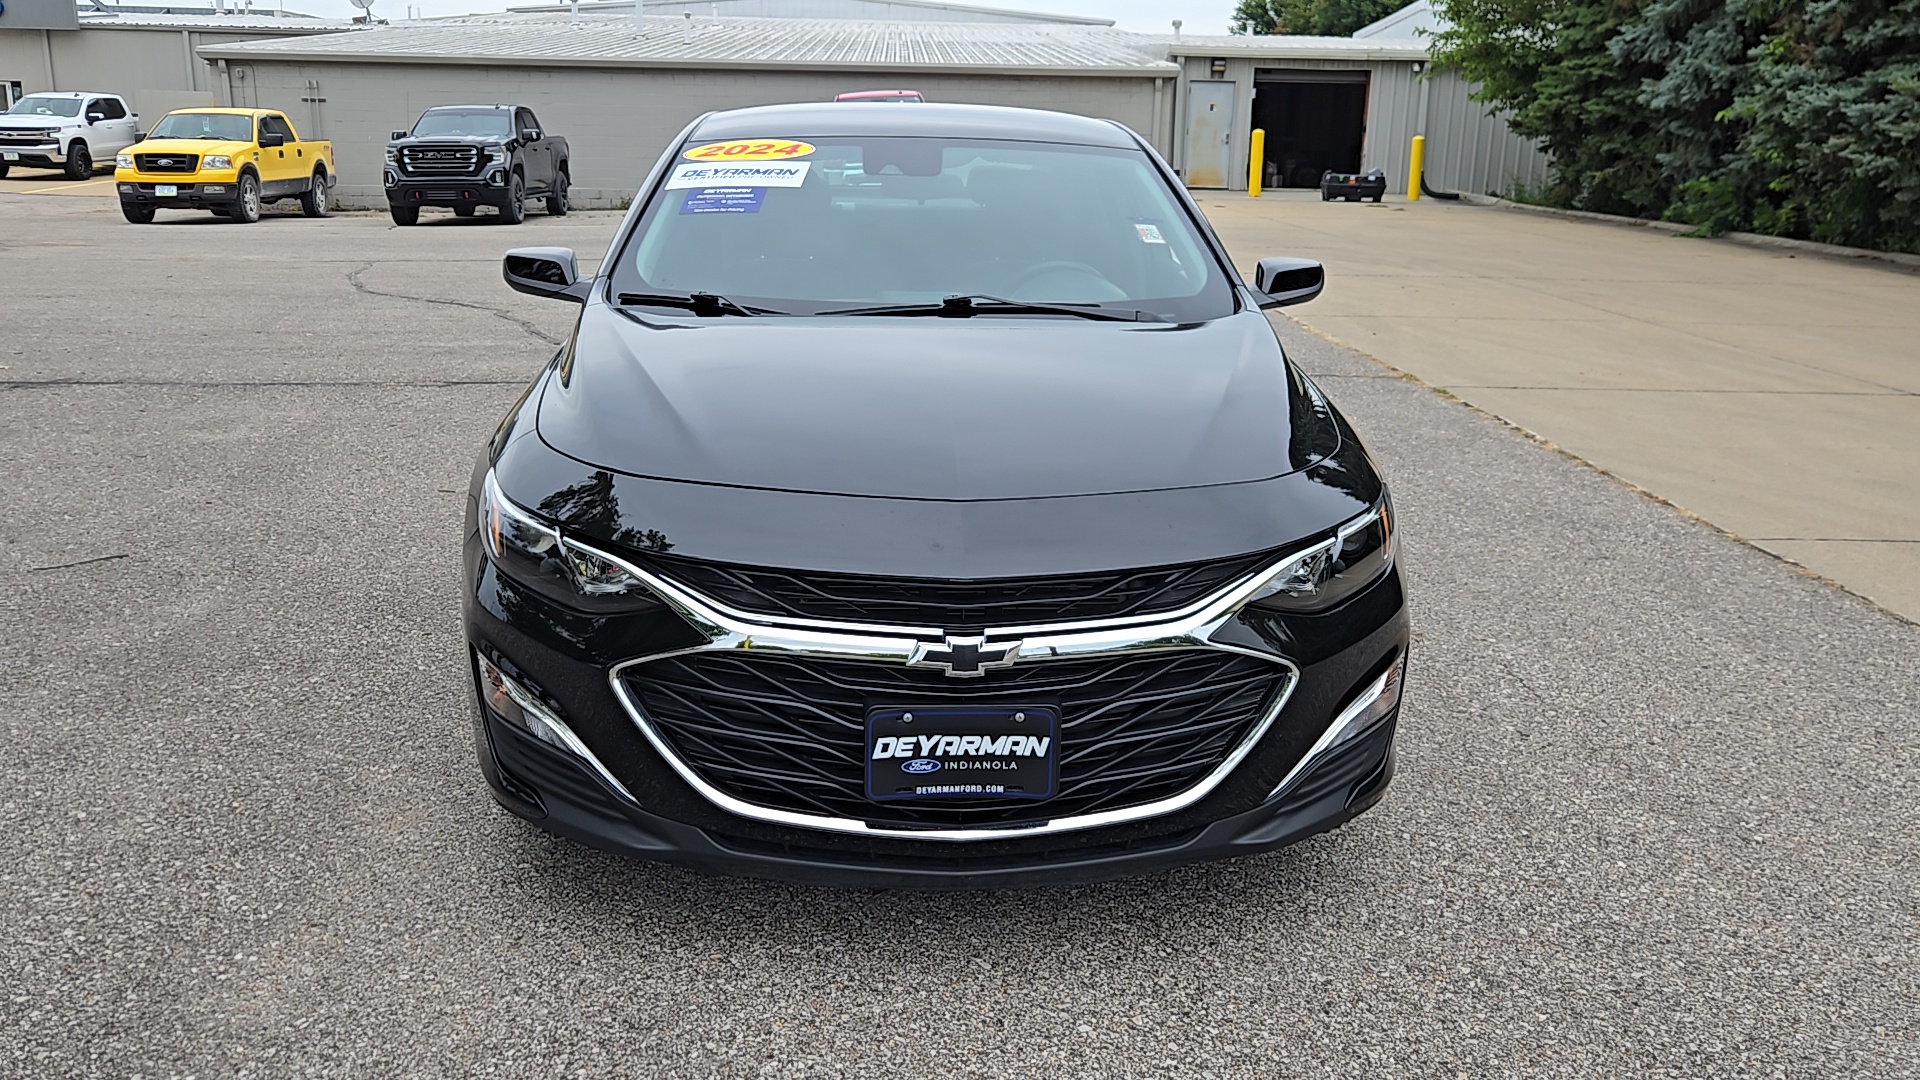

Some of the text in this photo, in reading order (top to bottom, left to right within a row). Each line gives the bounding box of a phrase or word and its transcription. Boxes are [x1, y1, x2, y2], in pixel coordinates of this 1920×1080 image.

[695, 144, 803, 158] 2024
[681, 168, 800, 178] DEYARMAN
[872, 735, 1050, 760] DEYARMAN
[906, 760, 1018, 771] Ford INDIANOLA
[916, 786, 1004, 794] DEYARMANFORD.COM
